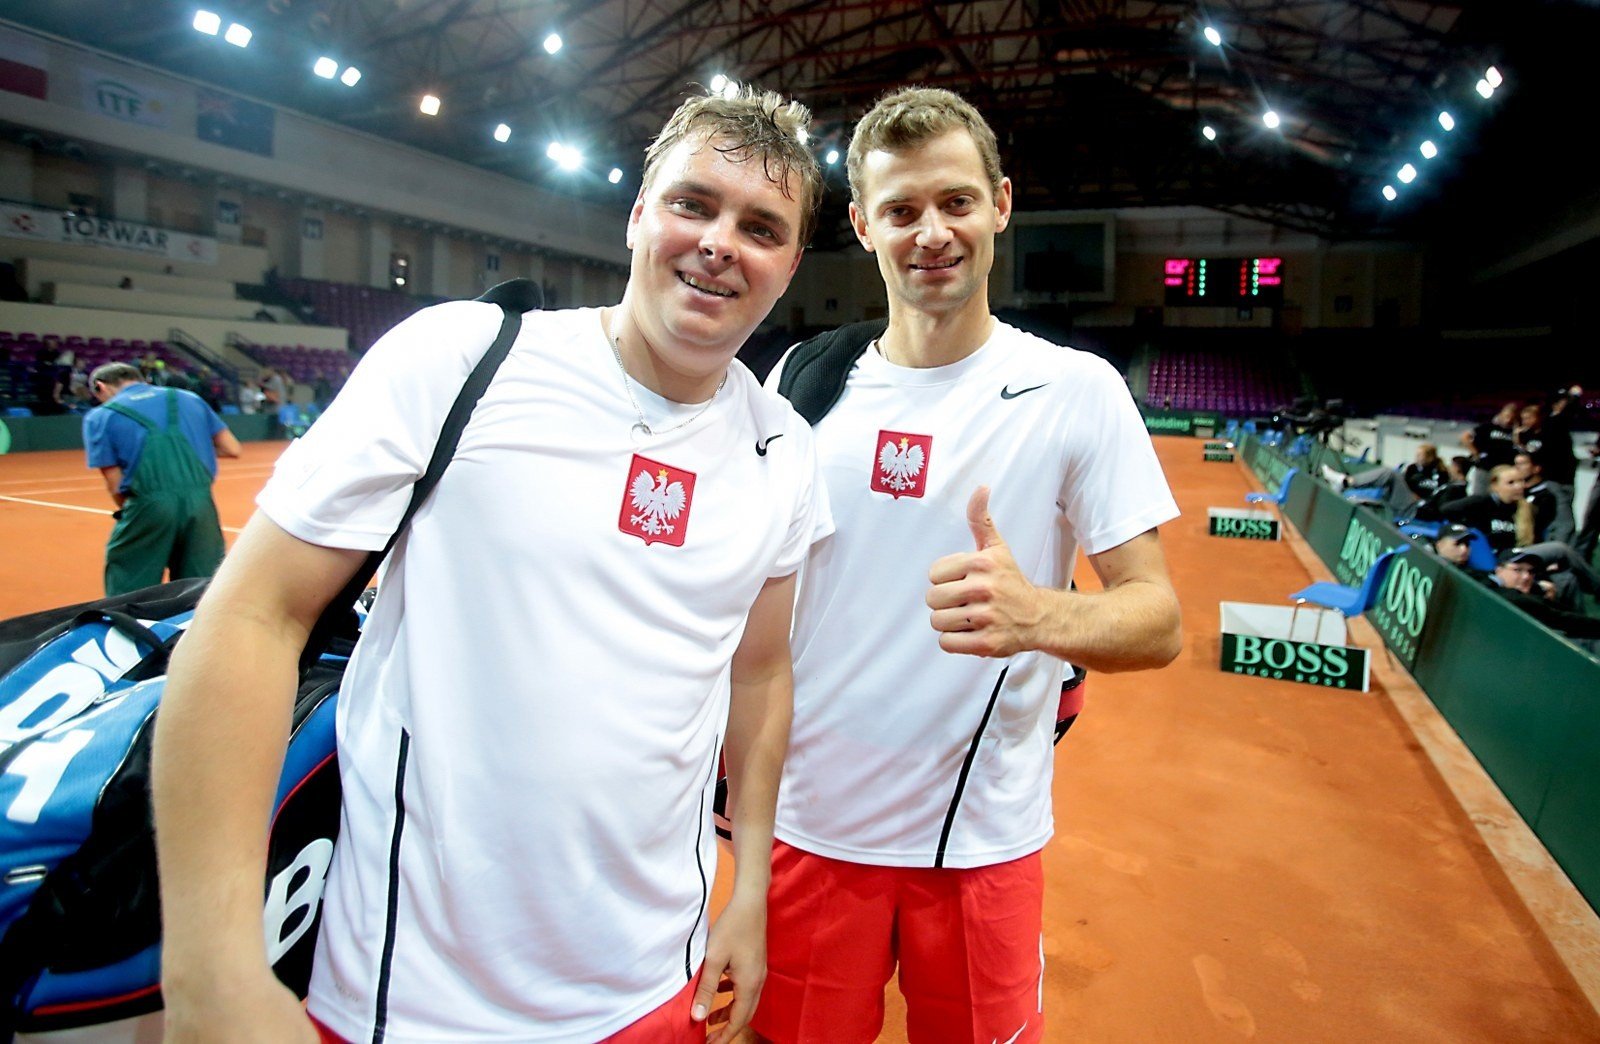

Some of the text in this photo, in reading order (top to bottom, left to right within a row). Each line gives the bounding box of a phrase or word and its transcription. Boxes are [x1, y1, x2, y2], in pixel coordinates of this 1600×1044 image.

[97, 88, 141, 116] ITF
[62, 214, 168, 248] TORWAR
[1216, 516, 1272, 536] BOSS
[1233, 634, 1349, 677] BOSS
